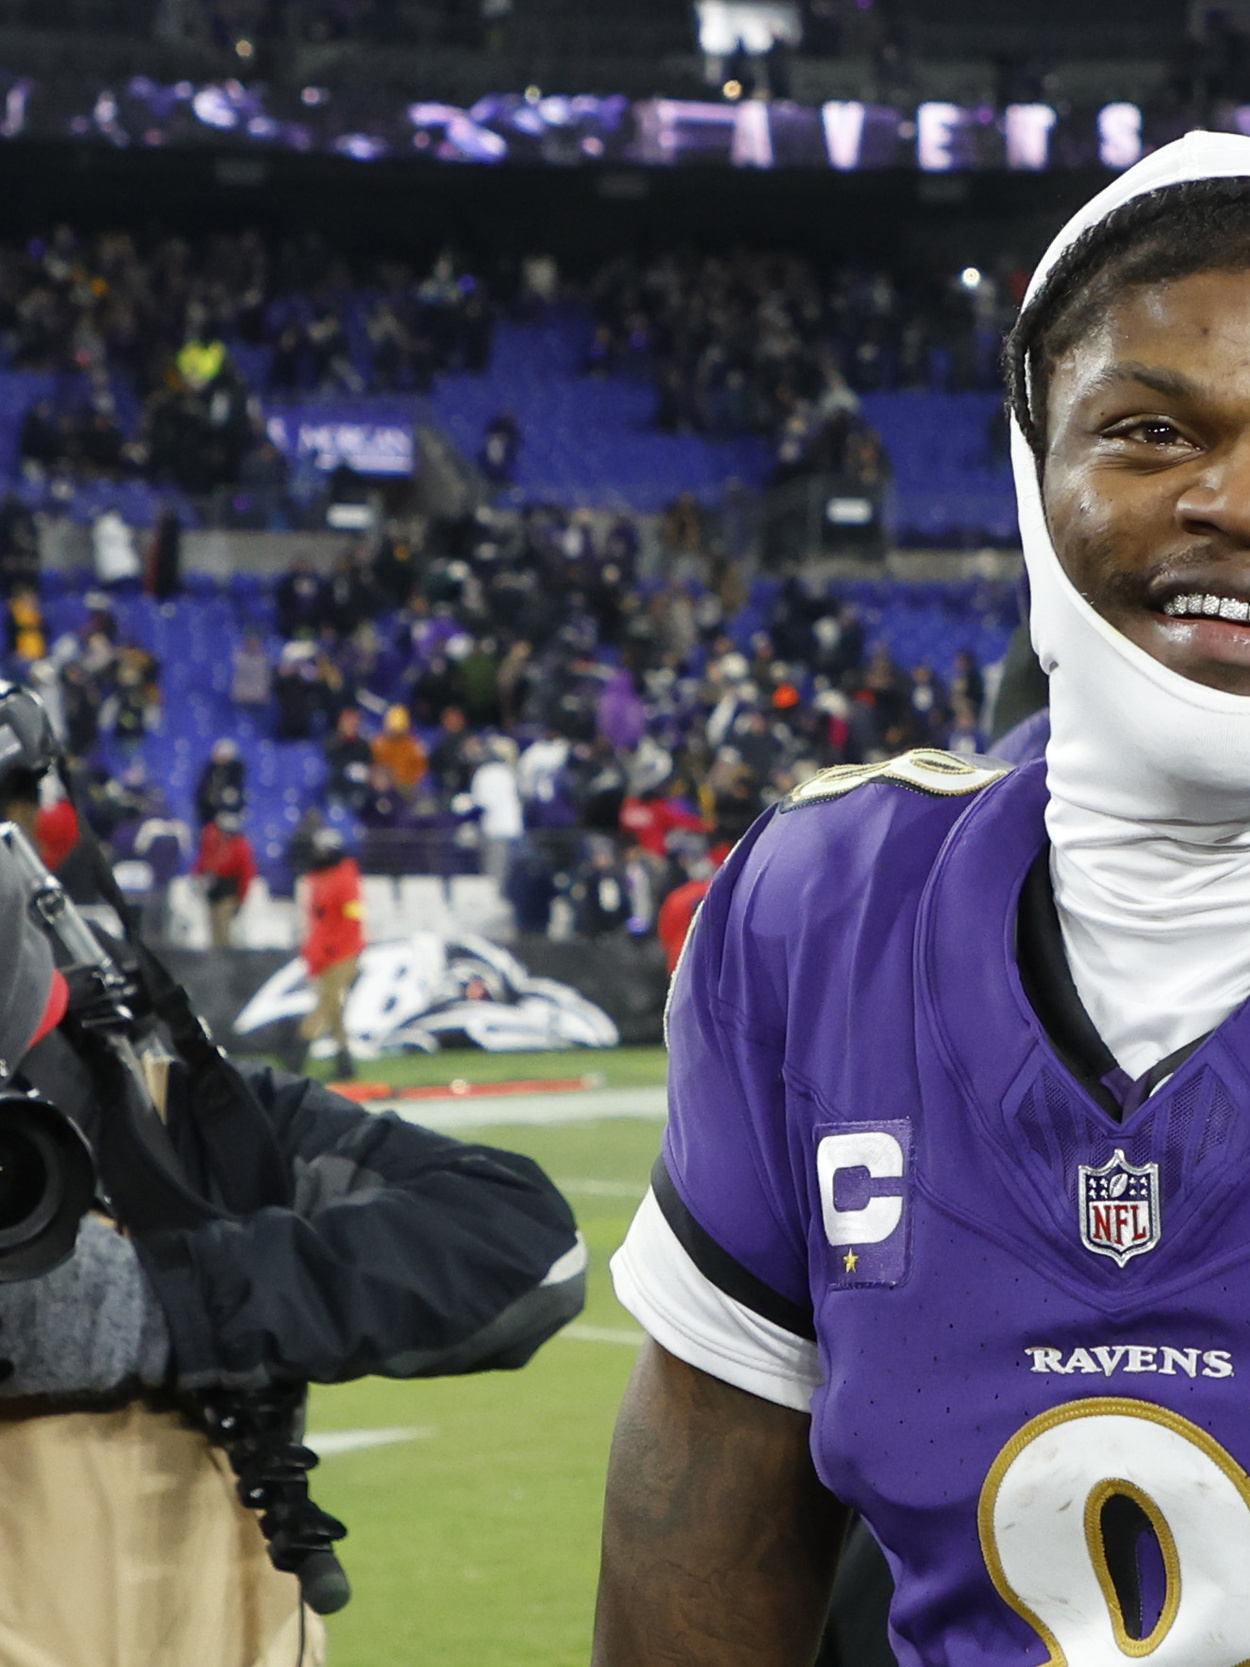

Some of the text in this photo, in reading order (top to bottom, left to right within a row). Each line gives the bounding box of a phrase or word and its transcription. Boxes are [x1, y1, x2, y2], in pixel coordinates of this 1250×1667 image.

[816, 1131, 904, 1247] C
[1092, 1205, 1148, 1247] NFL
[1024, 1345, 1235, 1379] RAVENS
